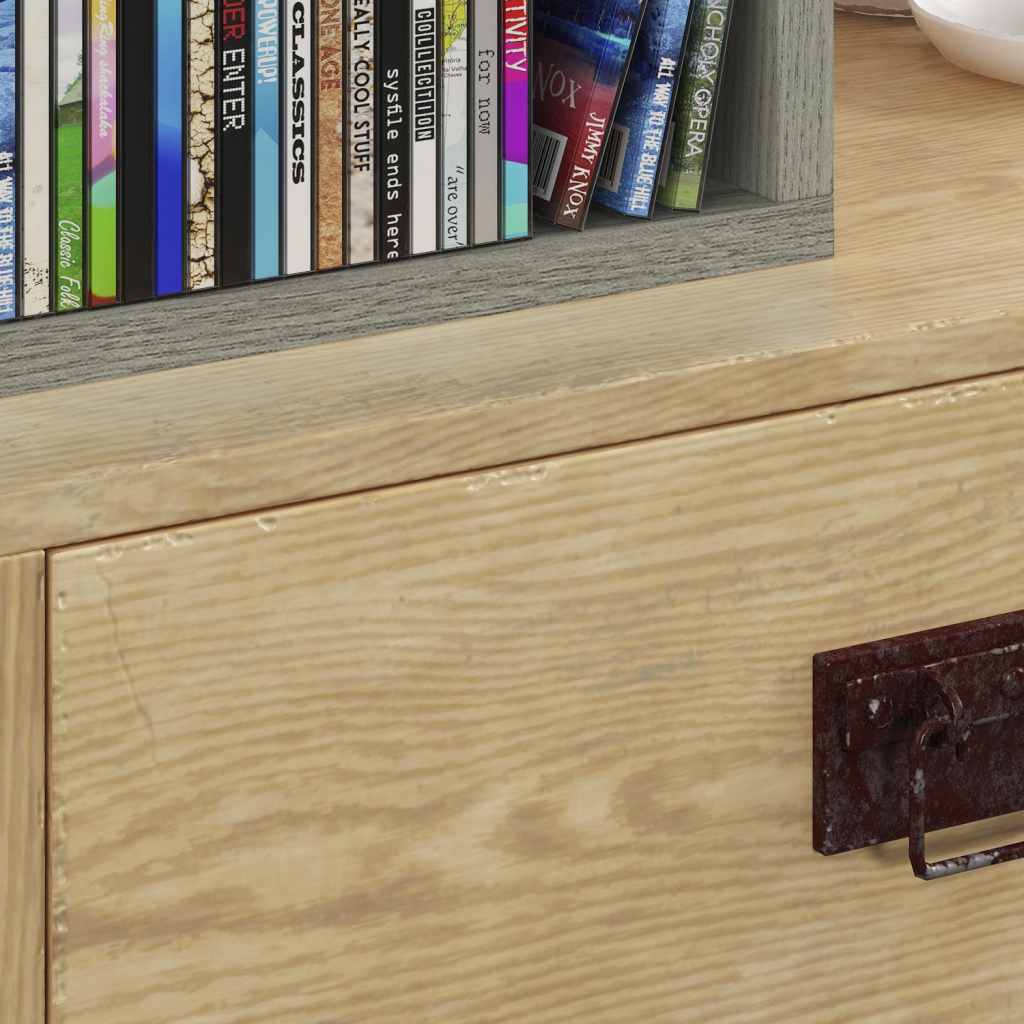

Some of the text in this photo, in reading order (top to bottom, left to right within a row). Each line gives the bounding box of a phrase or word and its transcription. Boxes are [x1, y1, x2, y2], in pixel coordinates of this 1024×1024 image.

[222, 48, 246, 132] ENTER
[292, 1, 305, 185] CLASSICS
[320, 45, 341, 91] AGE
[354, 59, 370, 114] COOL
[415, 7, 434, 142] COLLECTION
[478, 49, 495, 85] for
[657, 56, 676, 79] ALL
[478, 98, 491, 135] now
[648, 110, 667, 127] TO
[652, 81, 672, 109] WAY
[354, 121, 370, 172] STUFF
[642, 125, 664, 152] THE
[685, 88, 713, 159] OPERA
[383, 68, 403, 259] sysfile ends here
[563, 111, 606, 219] JIMMY KNOX
[58, 219, 81, 309] Classic Folk
